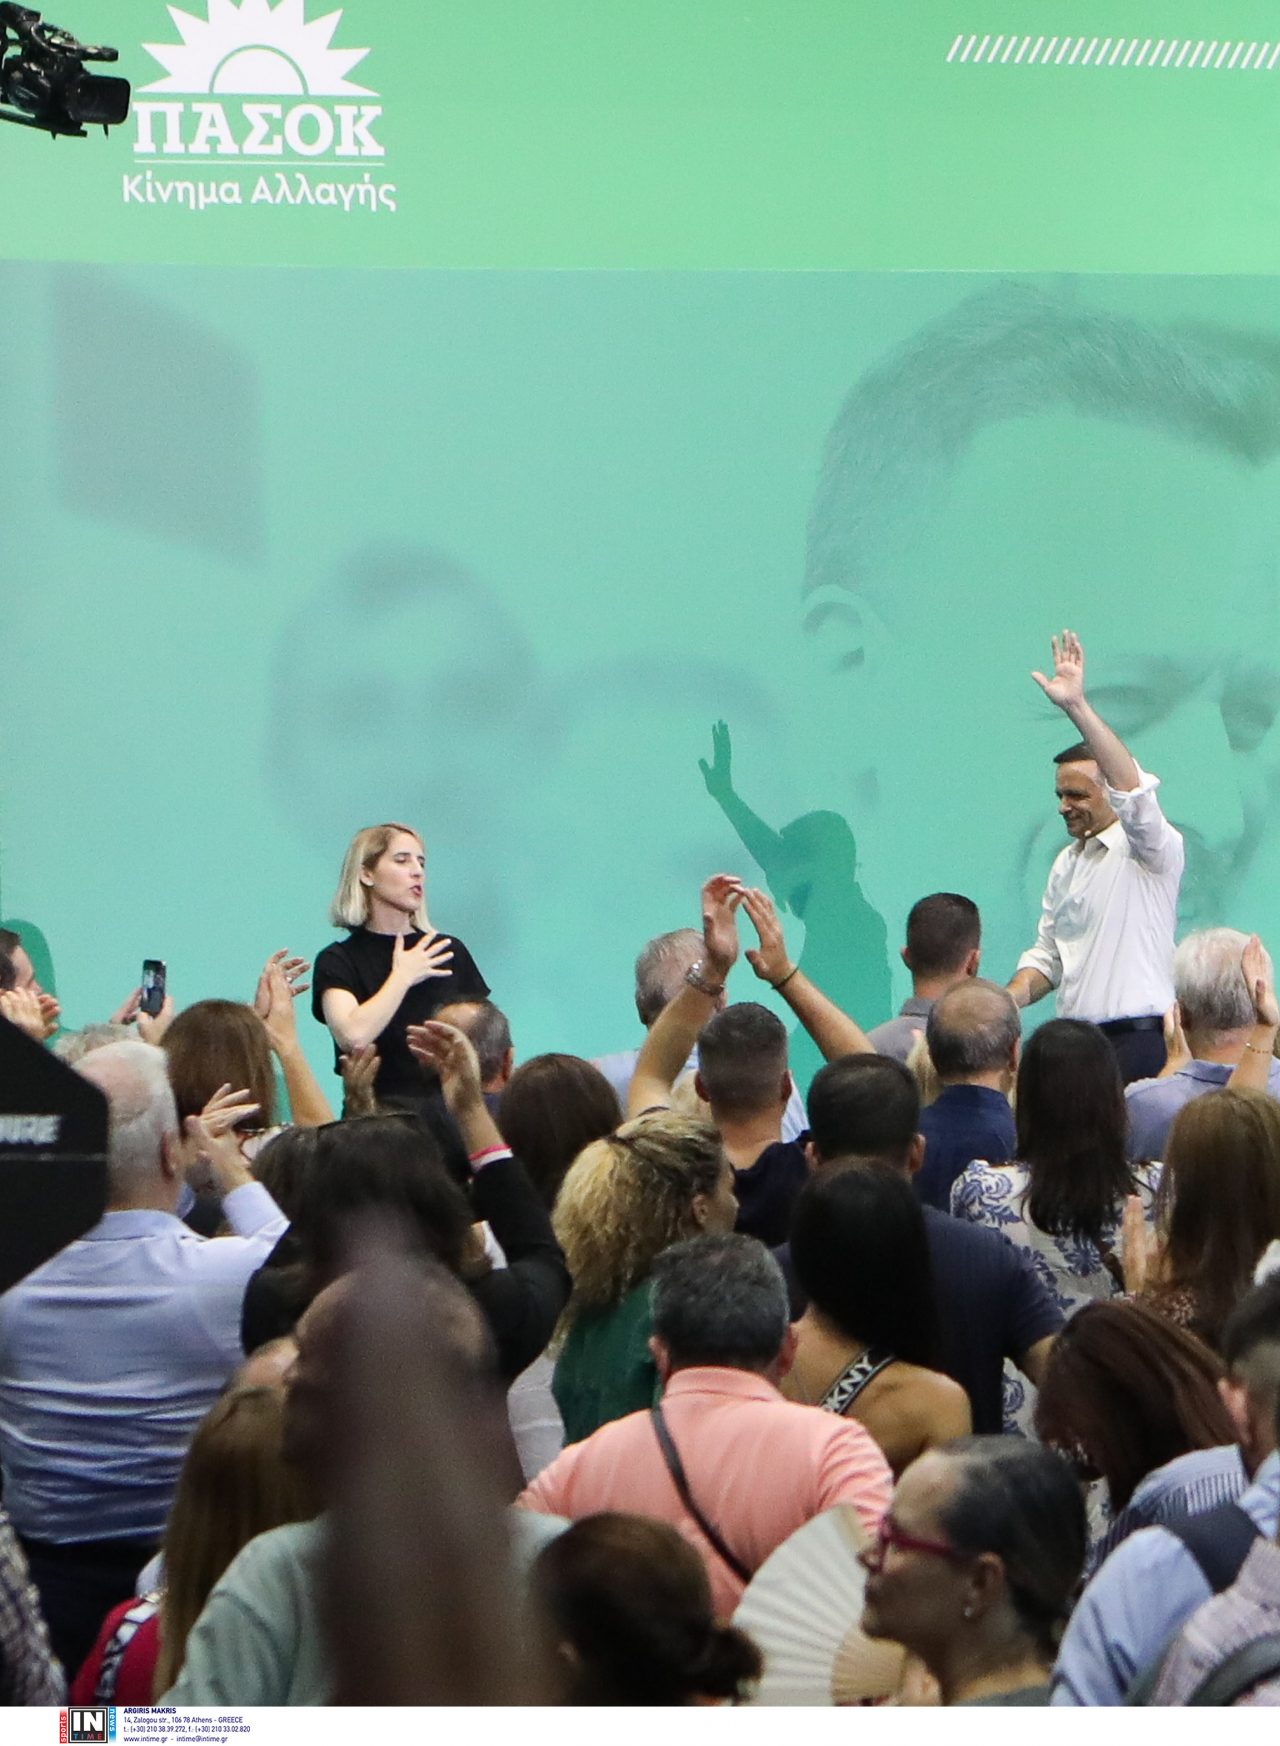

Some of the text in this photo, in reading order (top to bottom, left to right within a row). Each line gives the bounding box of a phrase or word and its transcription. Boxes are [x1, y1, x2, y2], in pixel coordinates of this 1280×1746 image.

[131, 102, 386, 156] ΠΑΣΟΚ
[122, 170, 397, 213] Κίνημα Αλλαγής
